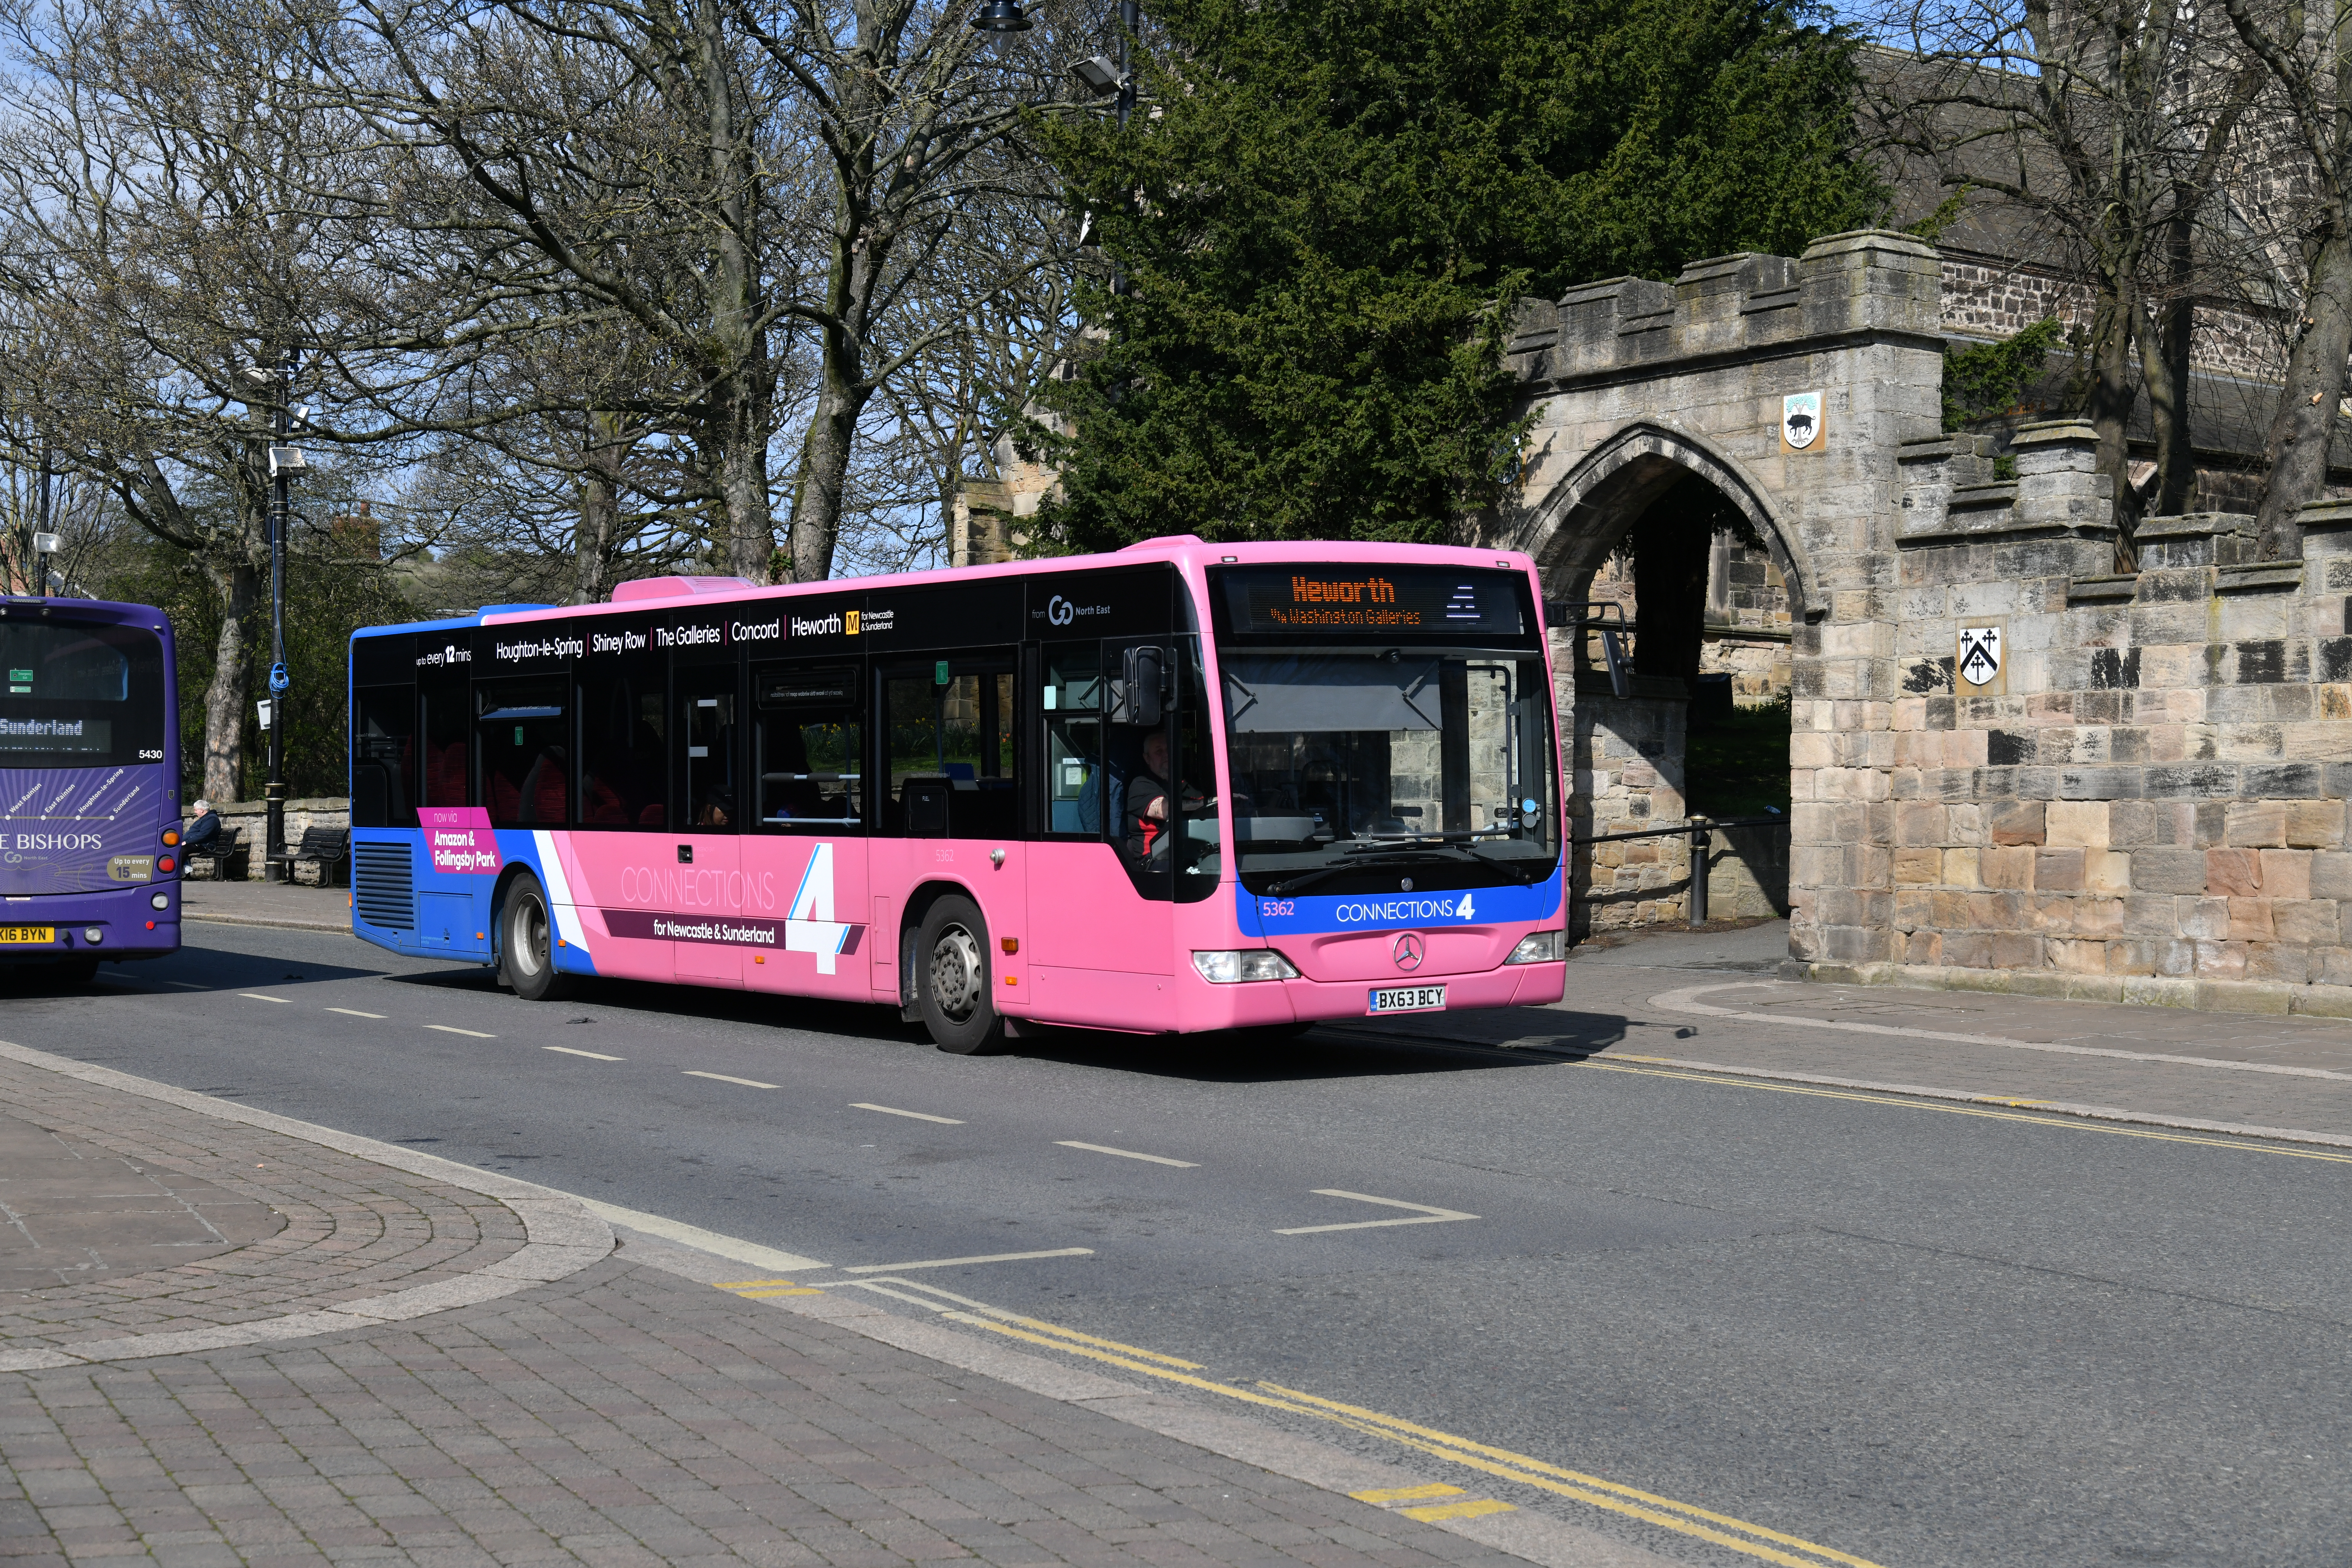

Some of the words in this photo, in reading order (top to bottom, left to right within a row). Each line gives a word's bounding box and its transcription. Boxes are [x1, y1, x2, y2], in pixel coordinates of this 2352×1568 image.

[1292, 577, 1395, 602] Heworth
[869, 610, 894, 620] Newcastle
[1032, 610, 1045, 618] from
[1076, 606, 1094, 615] North
[1096, 605, 1110, 614] East
[1290, 609, 1363, 624] Washington
[1367, 610, 1421, 624] Galleries
[732, 618, 779, 641] Concord
[792, 613, 841, 636] Heworth
[847, 614, 858, 631] M
[865, 621, 893, 631] Sunderland
[593, 633, 623, 655] Shiney
[625, 631, 646, 649] Row
[656, 628, 674, 646] The
[676, 624, 720, 645] Galleries
[427, 652, 444, 667] every
[445, 645, 455, 663] 12
[456, 648, 471, 662] mins
[497, 637, 583, 662] Houghton-le-Spring
[0, 719, 82, 735] Sunderland
[139, 750, 163, 759] 5430
[9, 800, 24, 813] West
[22, 783, 42, 801] Rainton
[44, 800, 58, 813] East
[55, 784, 76, 803] Rainton
[77, 768, 124, 814] Houghton-le-Spring
[113, 786, 140, 814] Sunderland
[434, 813, 447, 822] now
[448, 810, 457, 822] via
[17, 834, 102, 849] BISHOPS
[435, 830, 467, 846] Amazon
[469, 830, 475, 846] &
[435, 849, 475, 871] Follingsby
[476, 851, 496, 867] Park
[936, 849, 954, 861] 5362
[116, 866, 130, 878] 15
[621, 866, 775, 910] CONNECTIONS
[786, 843, 849, 975] 4
[1263, 901, 1294, 916] 5362
[1336, 899, 1453, 922] CONNECTIONS
[1456, 894, 1476, 920] 4
[21, 929, 46, 940] BYN
[654, 919, 666, 936] for
[667, 921, 713, 939] Newcastle
[714, 924, 721, 939] &
[722, 924, 775, 944] Sunderland
[1379, 991, 1414, 1008] BX63
[1418, 989, 1443, 1005] BCY
